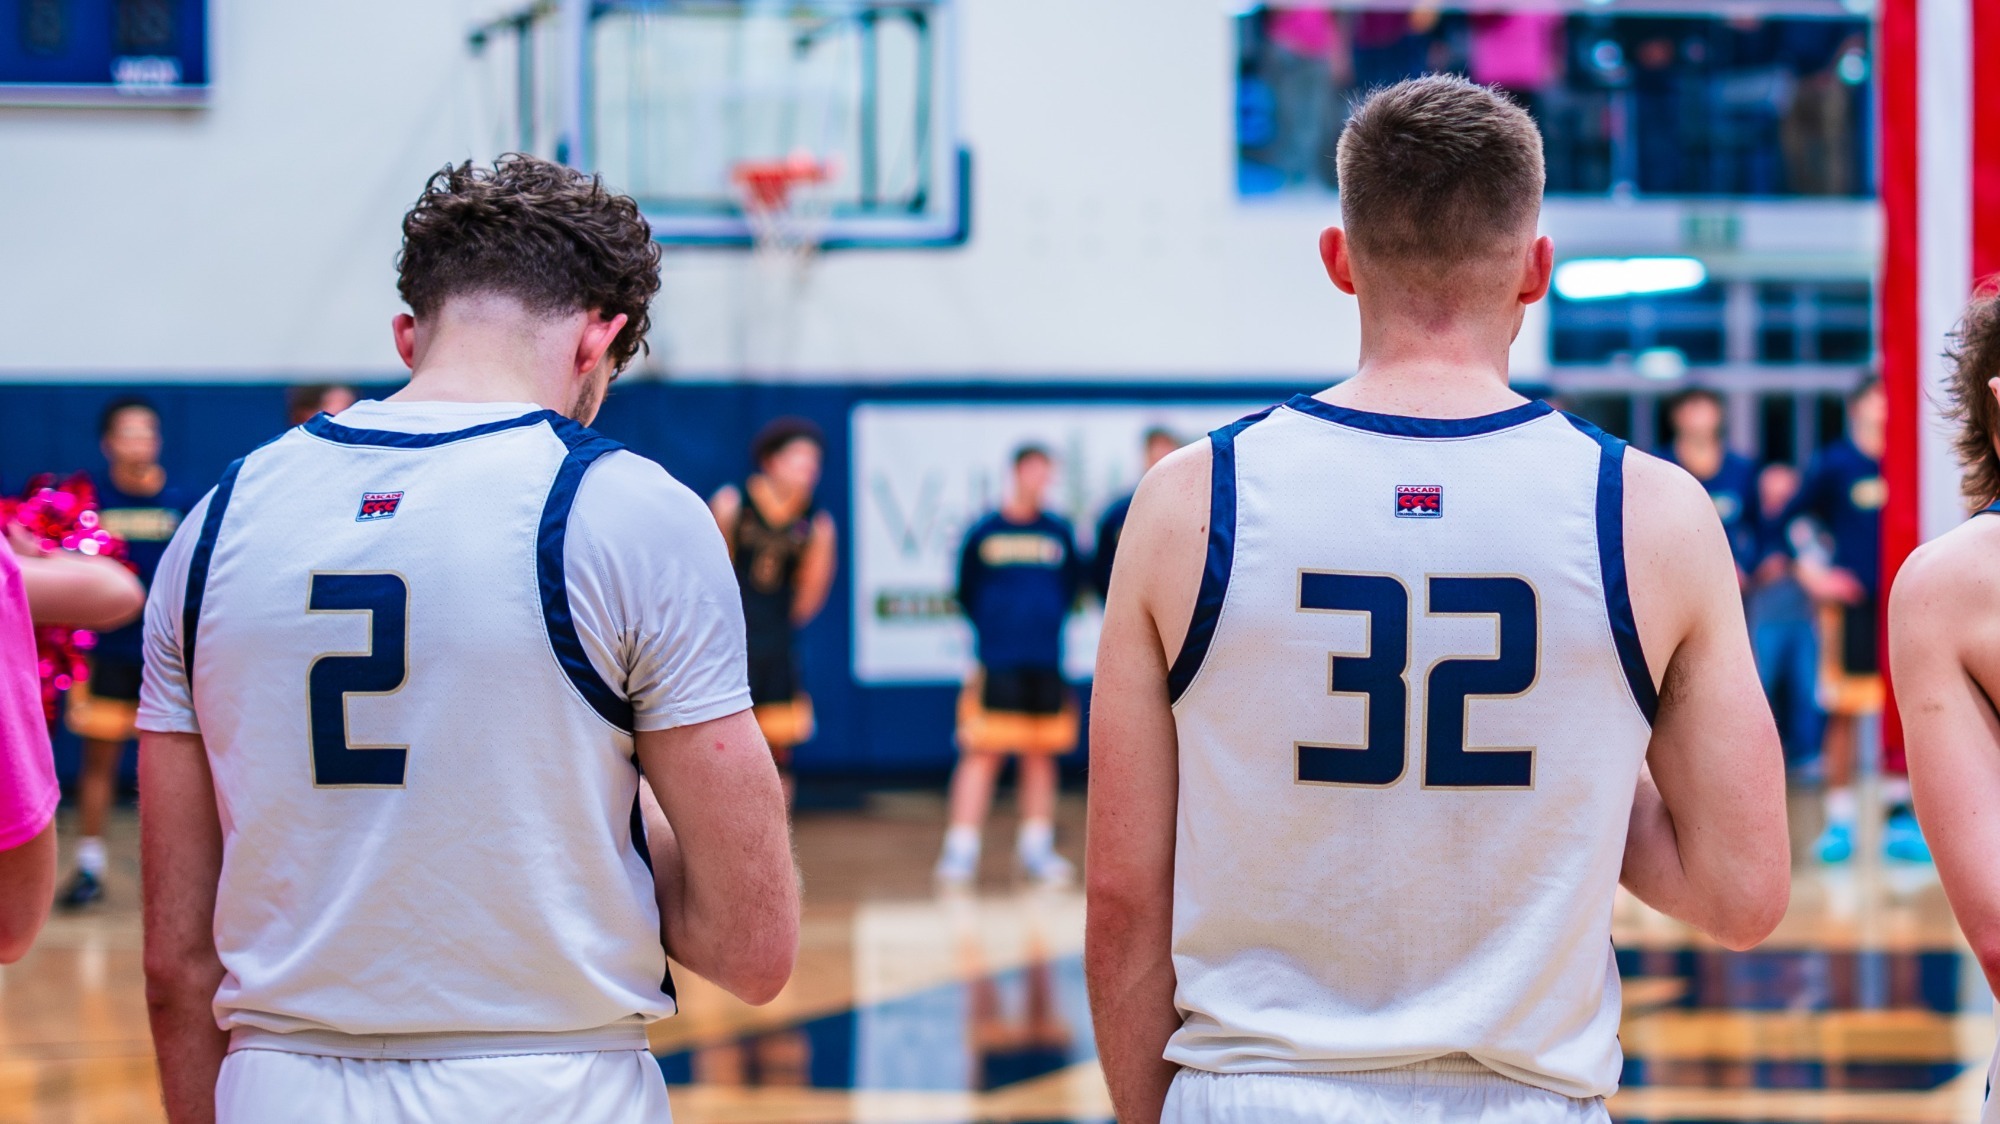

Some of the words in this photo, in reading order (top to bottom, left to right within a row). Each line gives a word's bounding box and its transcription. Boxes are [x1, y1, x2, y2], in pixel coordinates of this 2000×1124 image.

[363, 500, 398, 514] CCC
[1398, 494, 1439, 509] CCC
[305, 569, 411, 789] 2
[1293, 567, 1542, 791] 32
